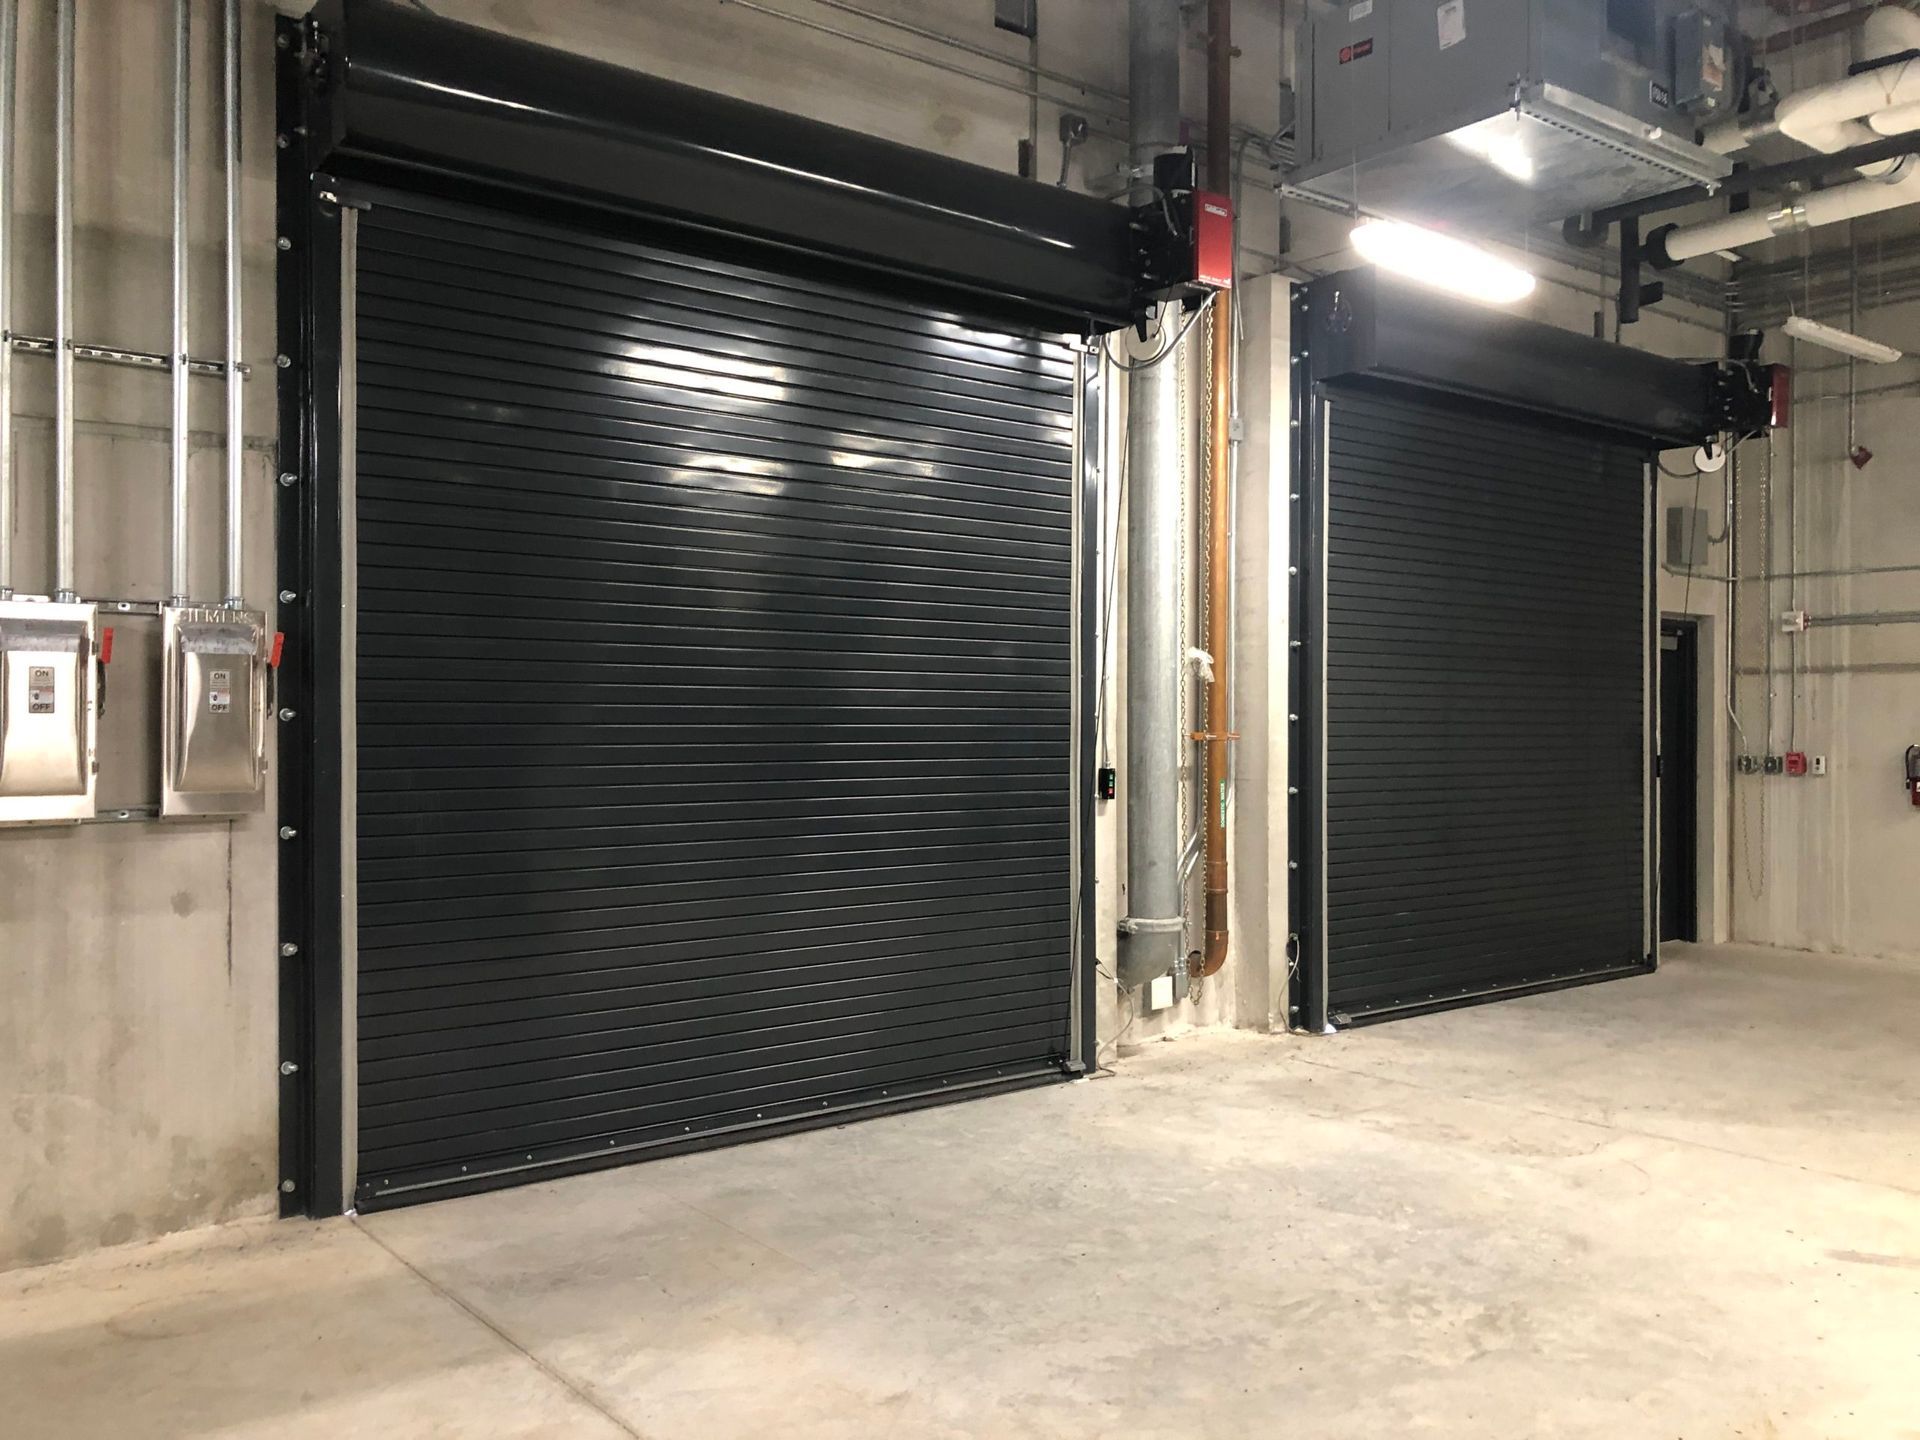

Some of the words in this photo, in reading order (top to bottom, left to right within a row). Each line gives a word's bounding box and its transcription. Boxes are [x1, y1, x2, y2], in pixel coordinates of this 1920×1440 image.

[34, 670, 49, 678] ON
[213, 672, 226, 680] ON
[32, 703, 51, 711] OFF
[211, 703, 227, 711] OFF
